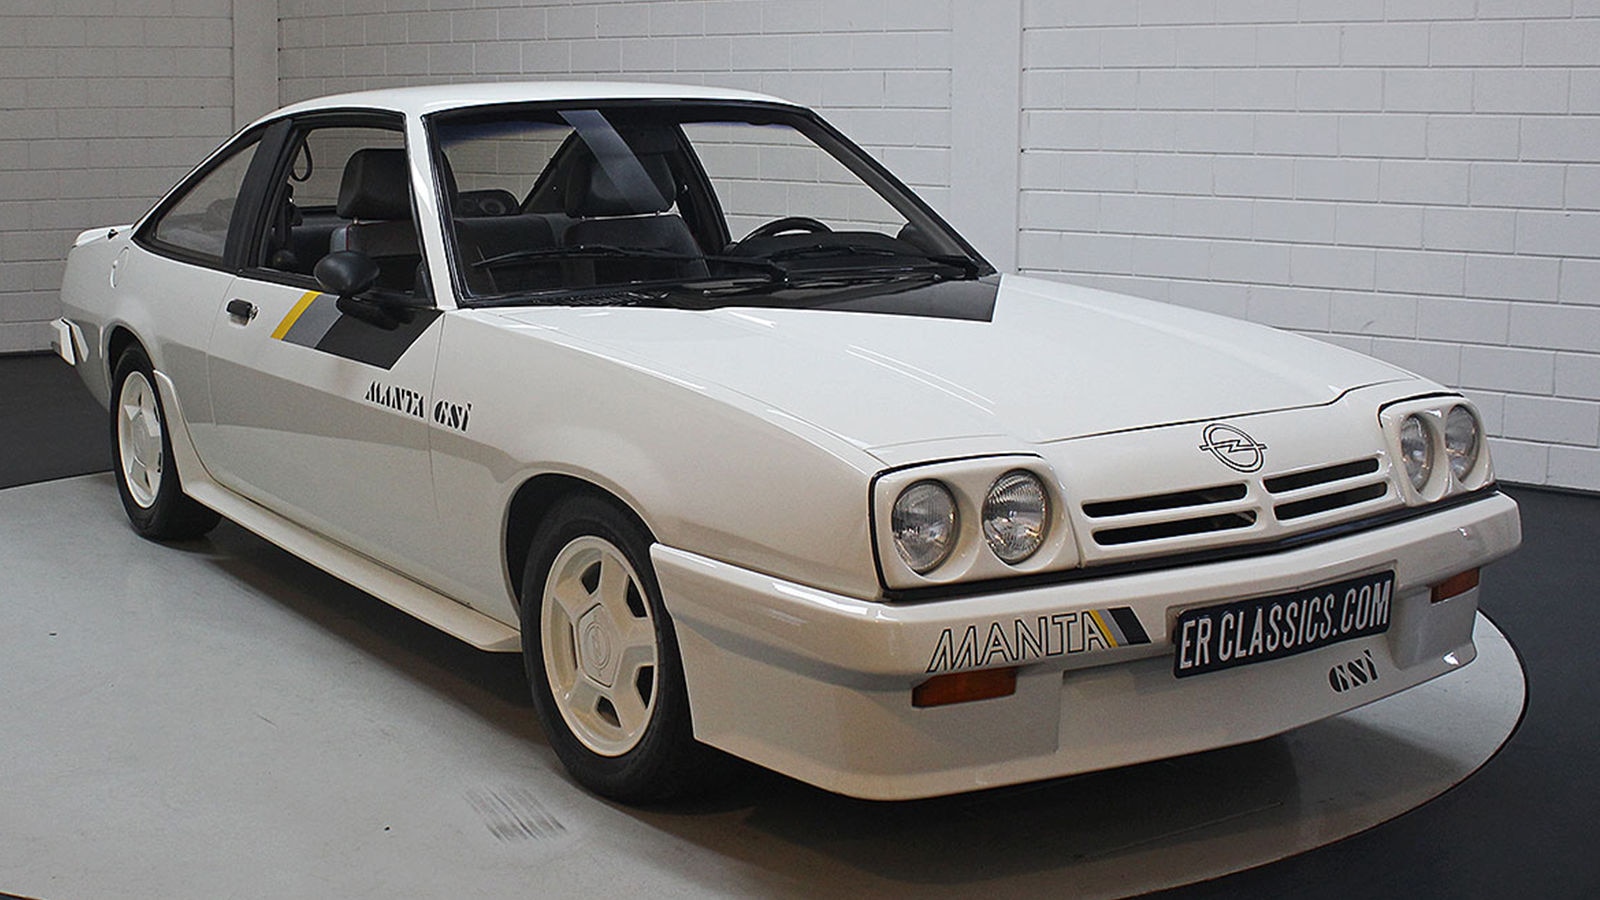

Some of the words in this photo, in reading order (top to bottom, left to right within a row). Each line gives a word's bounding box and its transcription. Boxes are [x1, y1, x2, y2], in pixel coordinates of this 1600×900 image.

[365, 381, 424, 418] MANTA
[926, 610, 1112, 673] MANTA
[1179, 617, 1212, 669] ER
[1218, 580, 1391, 662] CLASSICS.COM
